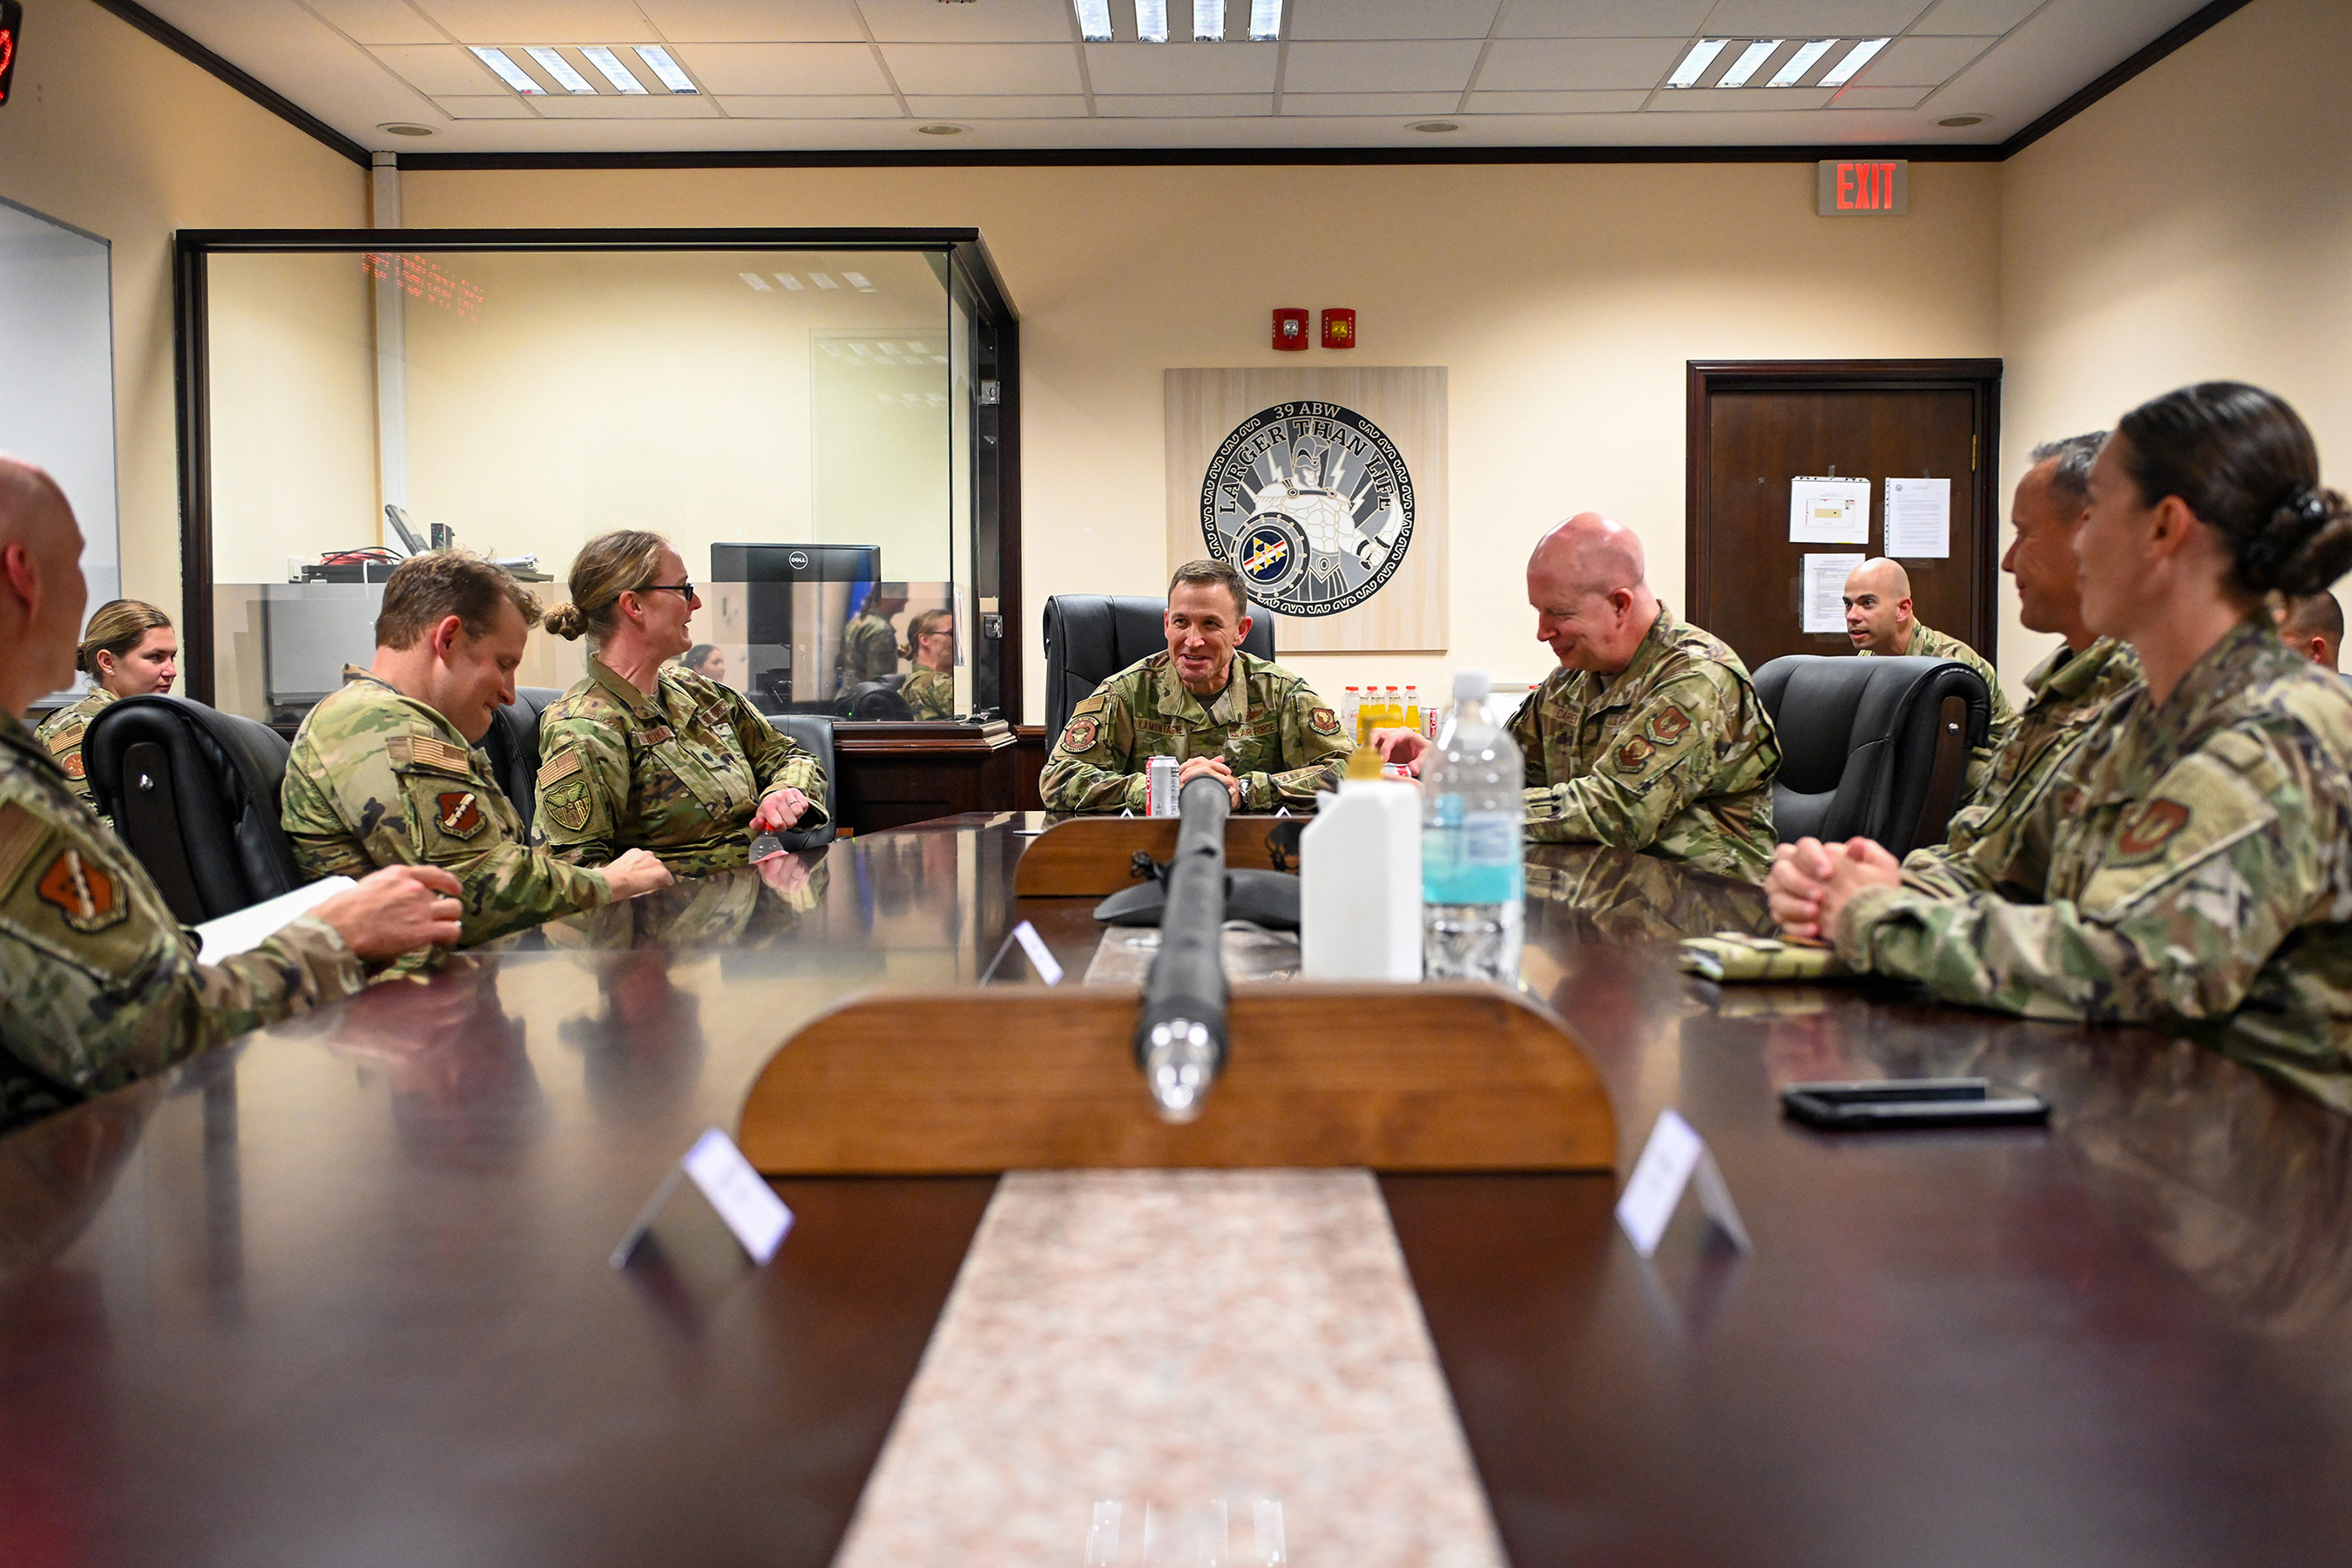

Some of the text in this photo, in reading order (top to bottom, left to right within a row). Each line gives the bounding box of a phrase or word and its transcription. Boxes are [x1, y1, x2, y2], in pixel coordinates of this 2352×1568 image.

[1837, 163, 1896, 209] EXIT
[1274, 402, 1341, 419] 39 ABW
[1220, 419, 1395, 515] LARGER THAN LIFE
[1139, 721, 1183, 735] LAMONTAGNE
[1240, 728, 1253, 738] AIR
[1254, 723, 1275, 737] FORCE
